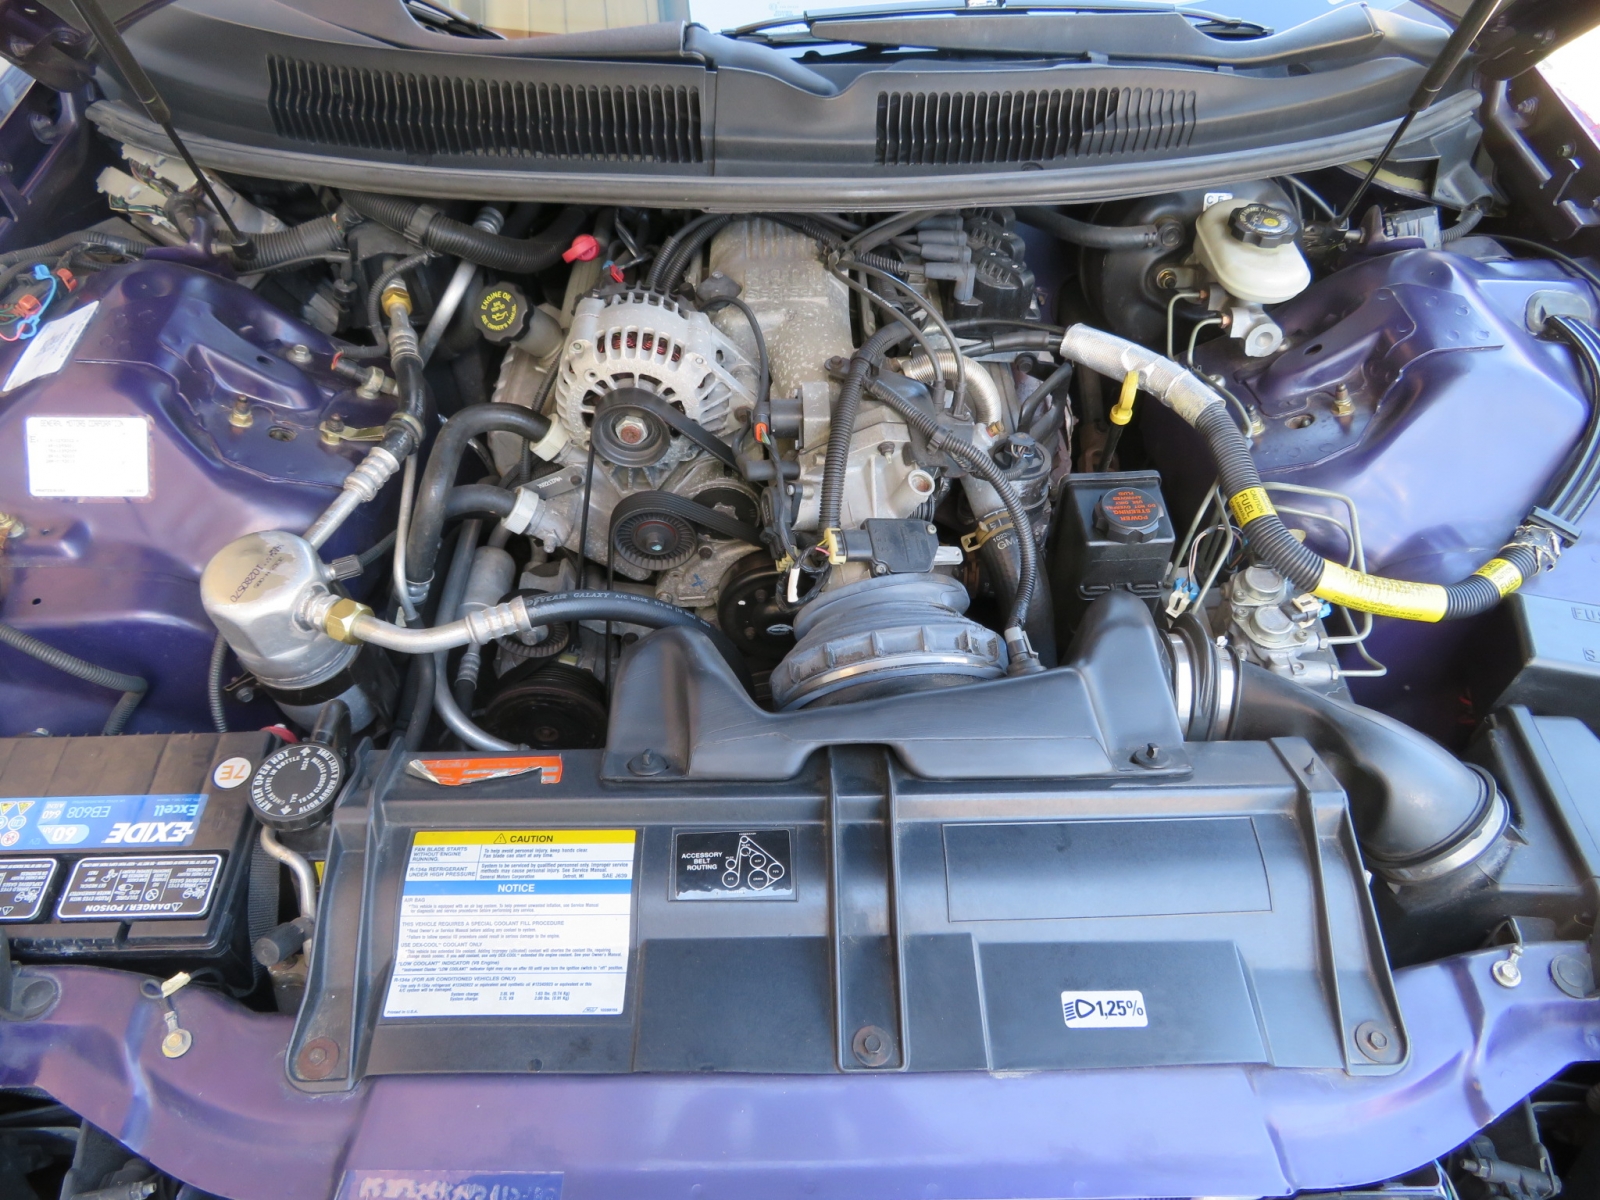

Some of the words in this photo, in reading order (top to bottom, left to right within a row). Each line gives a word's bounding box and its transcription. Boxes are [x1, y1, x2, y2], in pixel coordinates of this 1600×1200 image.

[481, 291, 501, 310] ENGINE
[502, 293, 512, 302] OIL
[1239, 493, 1254, 517] FUEL
[254, 764, 272, 786] OPEN
[270, 749, 289, 764] HOT
[42, 810, 61, 818] 640
[67, 805, 111, 818] EB608
[155, 804, 199, 816] Excell
[52, 826, 78, 841] 60
[107, 821, 194, 843] EXIDE
[510, 835, 554, 843] CAUTION
[498, 884, 535, 892] NOTICE
[1096, 1000, 1144, 1020] 1,25%
